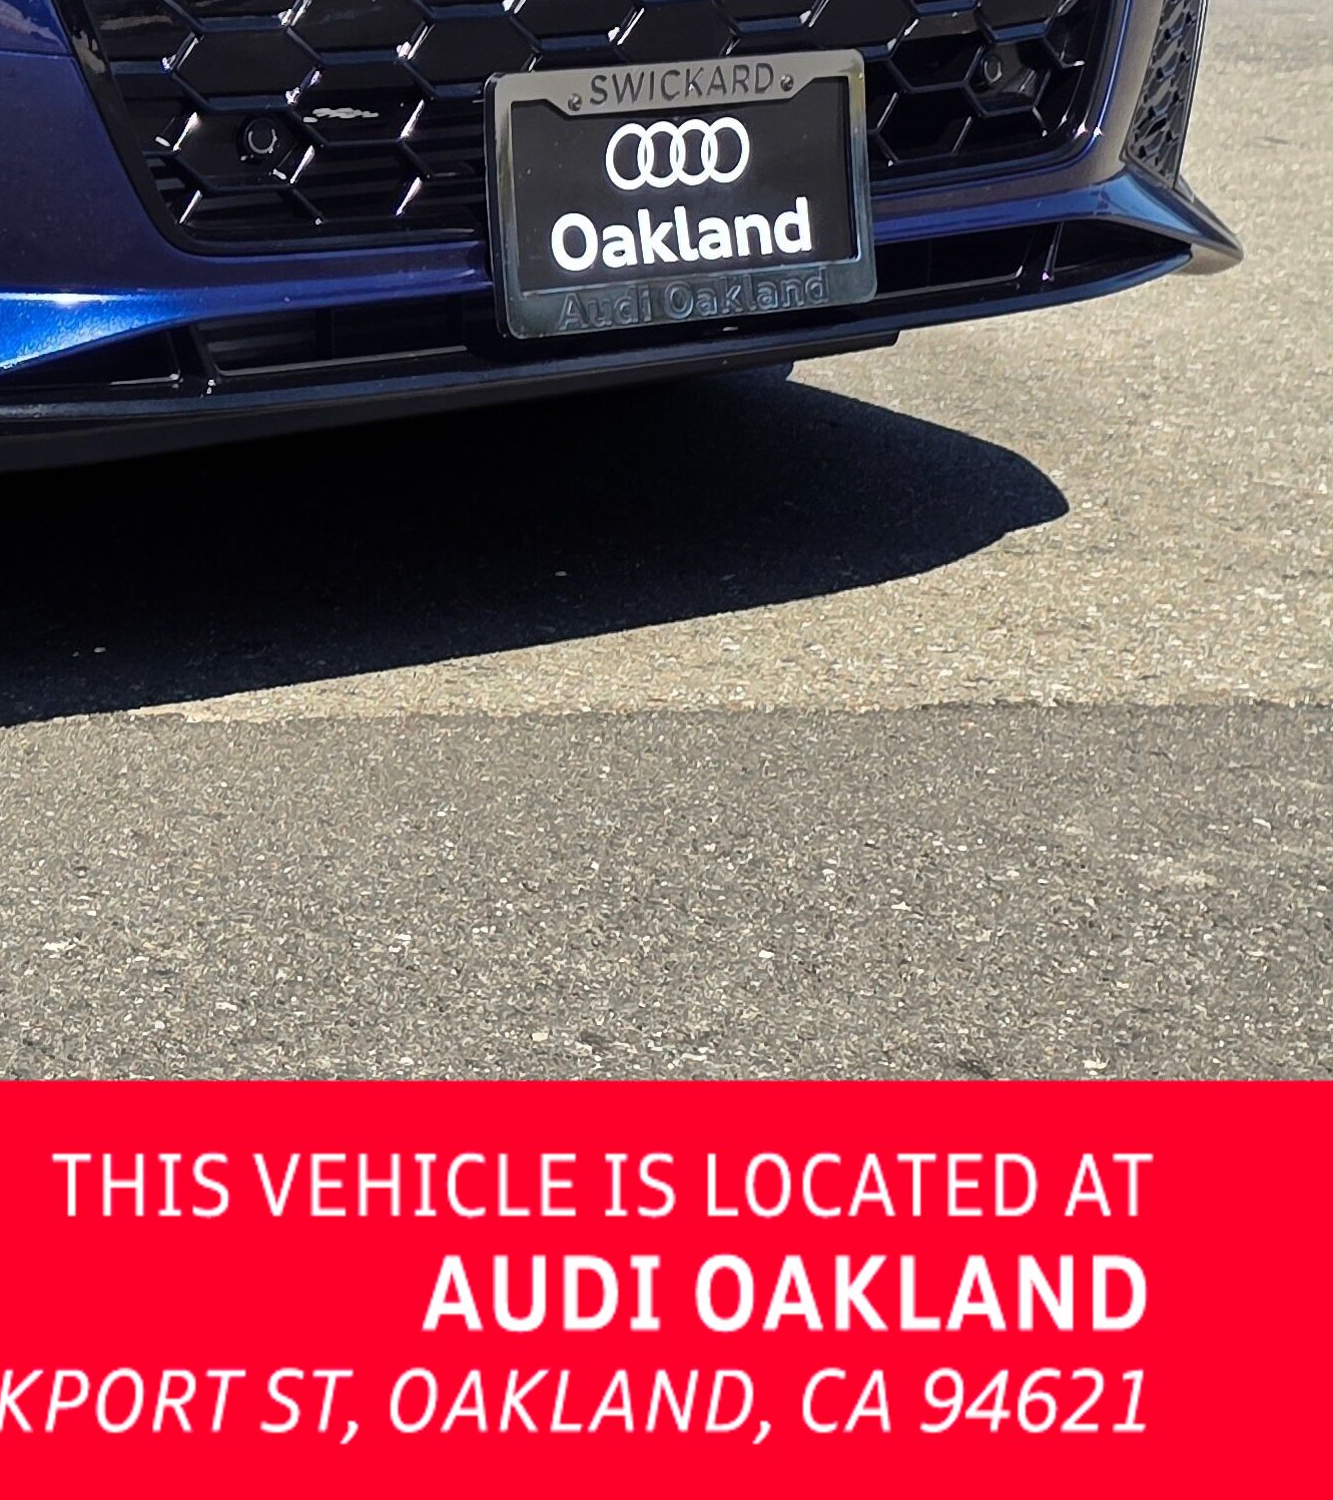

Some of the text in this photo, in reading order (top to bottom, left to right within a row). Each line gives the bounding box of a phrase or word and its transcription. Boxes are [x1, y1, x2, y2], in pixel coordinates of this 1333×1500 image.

[589, 62, 774, 105] SWICKARD
[550, 196, 814, 272] Oakland
[558, 266, 831, 331] Audi Oakland
